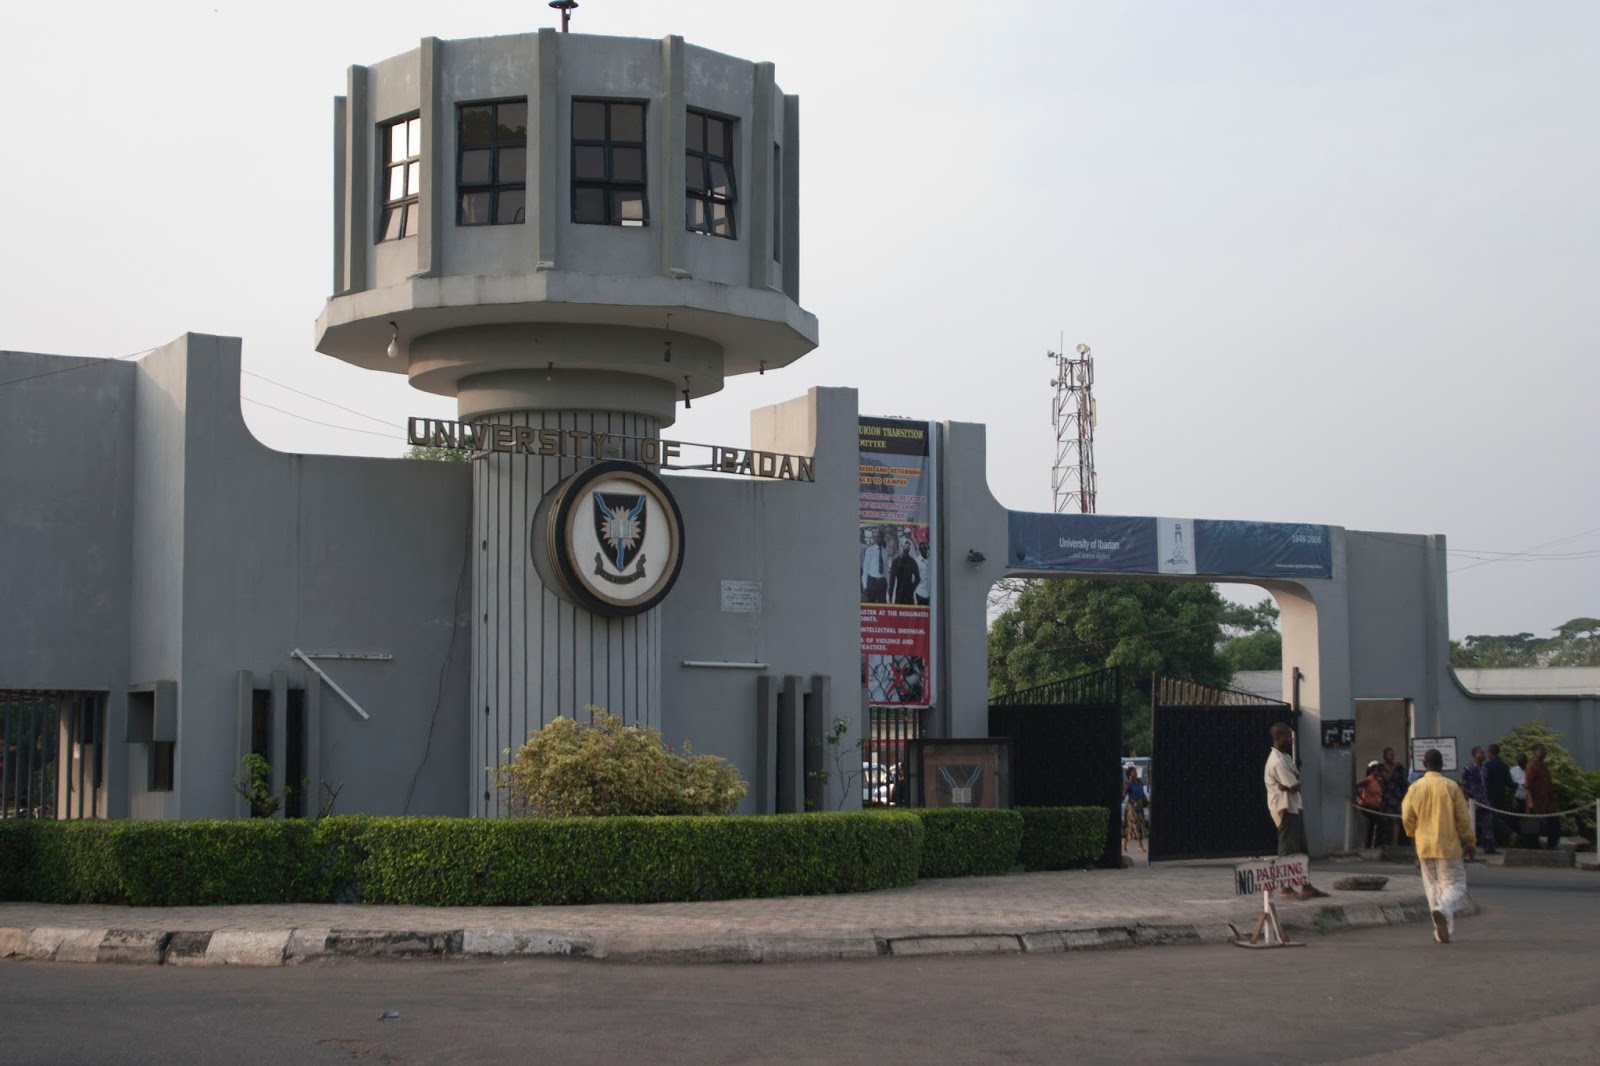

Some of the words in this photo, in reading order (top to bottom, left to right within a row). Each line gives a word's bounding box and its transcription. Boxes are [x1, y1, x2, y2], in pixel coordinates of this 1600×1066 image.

[859, 426, 880, 436] UNION
[882, 427, 924, 439] TRANSITION
[408, 416, 607, 459] UNIVERSITY
[641, 437, 681, 467] OF
[713, 445, 815, 482] IBADAN
[890, 468, 923, 476] RETURNING
[1059, 537, 1089, 551] University
[1090, 539, 1097, 549] of
[1097, 539, 1120, 550] Ibadan
[1238, 869, 1254, 895] NO
[1256, 862, 1302, 881] PARKING
[1255, 876, 1307, 893] HAWKING
